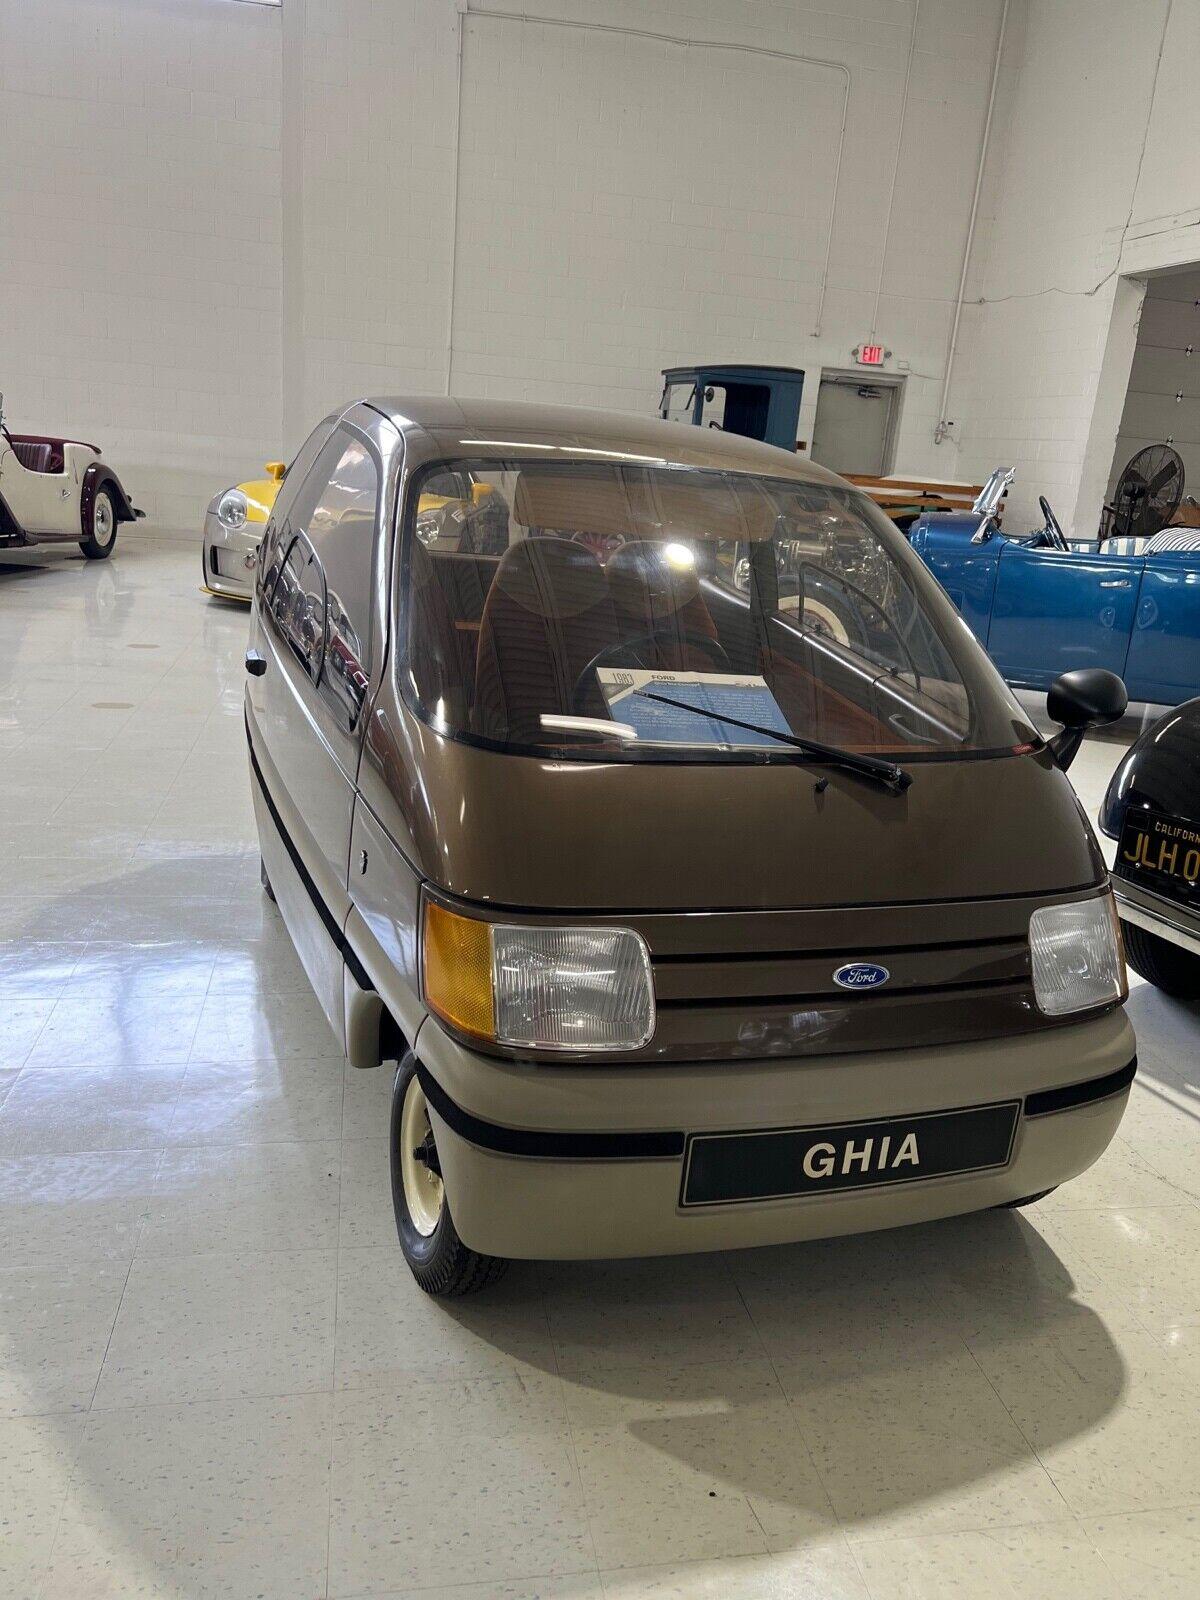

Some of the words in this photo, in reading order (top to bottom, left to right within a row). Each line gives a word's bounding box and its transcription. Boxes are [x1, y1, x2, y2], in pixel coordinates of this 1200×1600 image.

[863, 346, 882, 362] EXIT
[612, 672, 635, 685] 1983
[651, 674, 675, 682] FORD
[847, 968, 877, 983] Ford
[802, 1133, 920, 1178] GHIA
